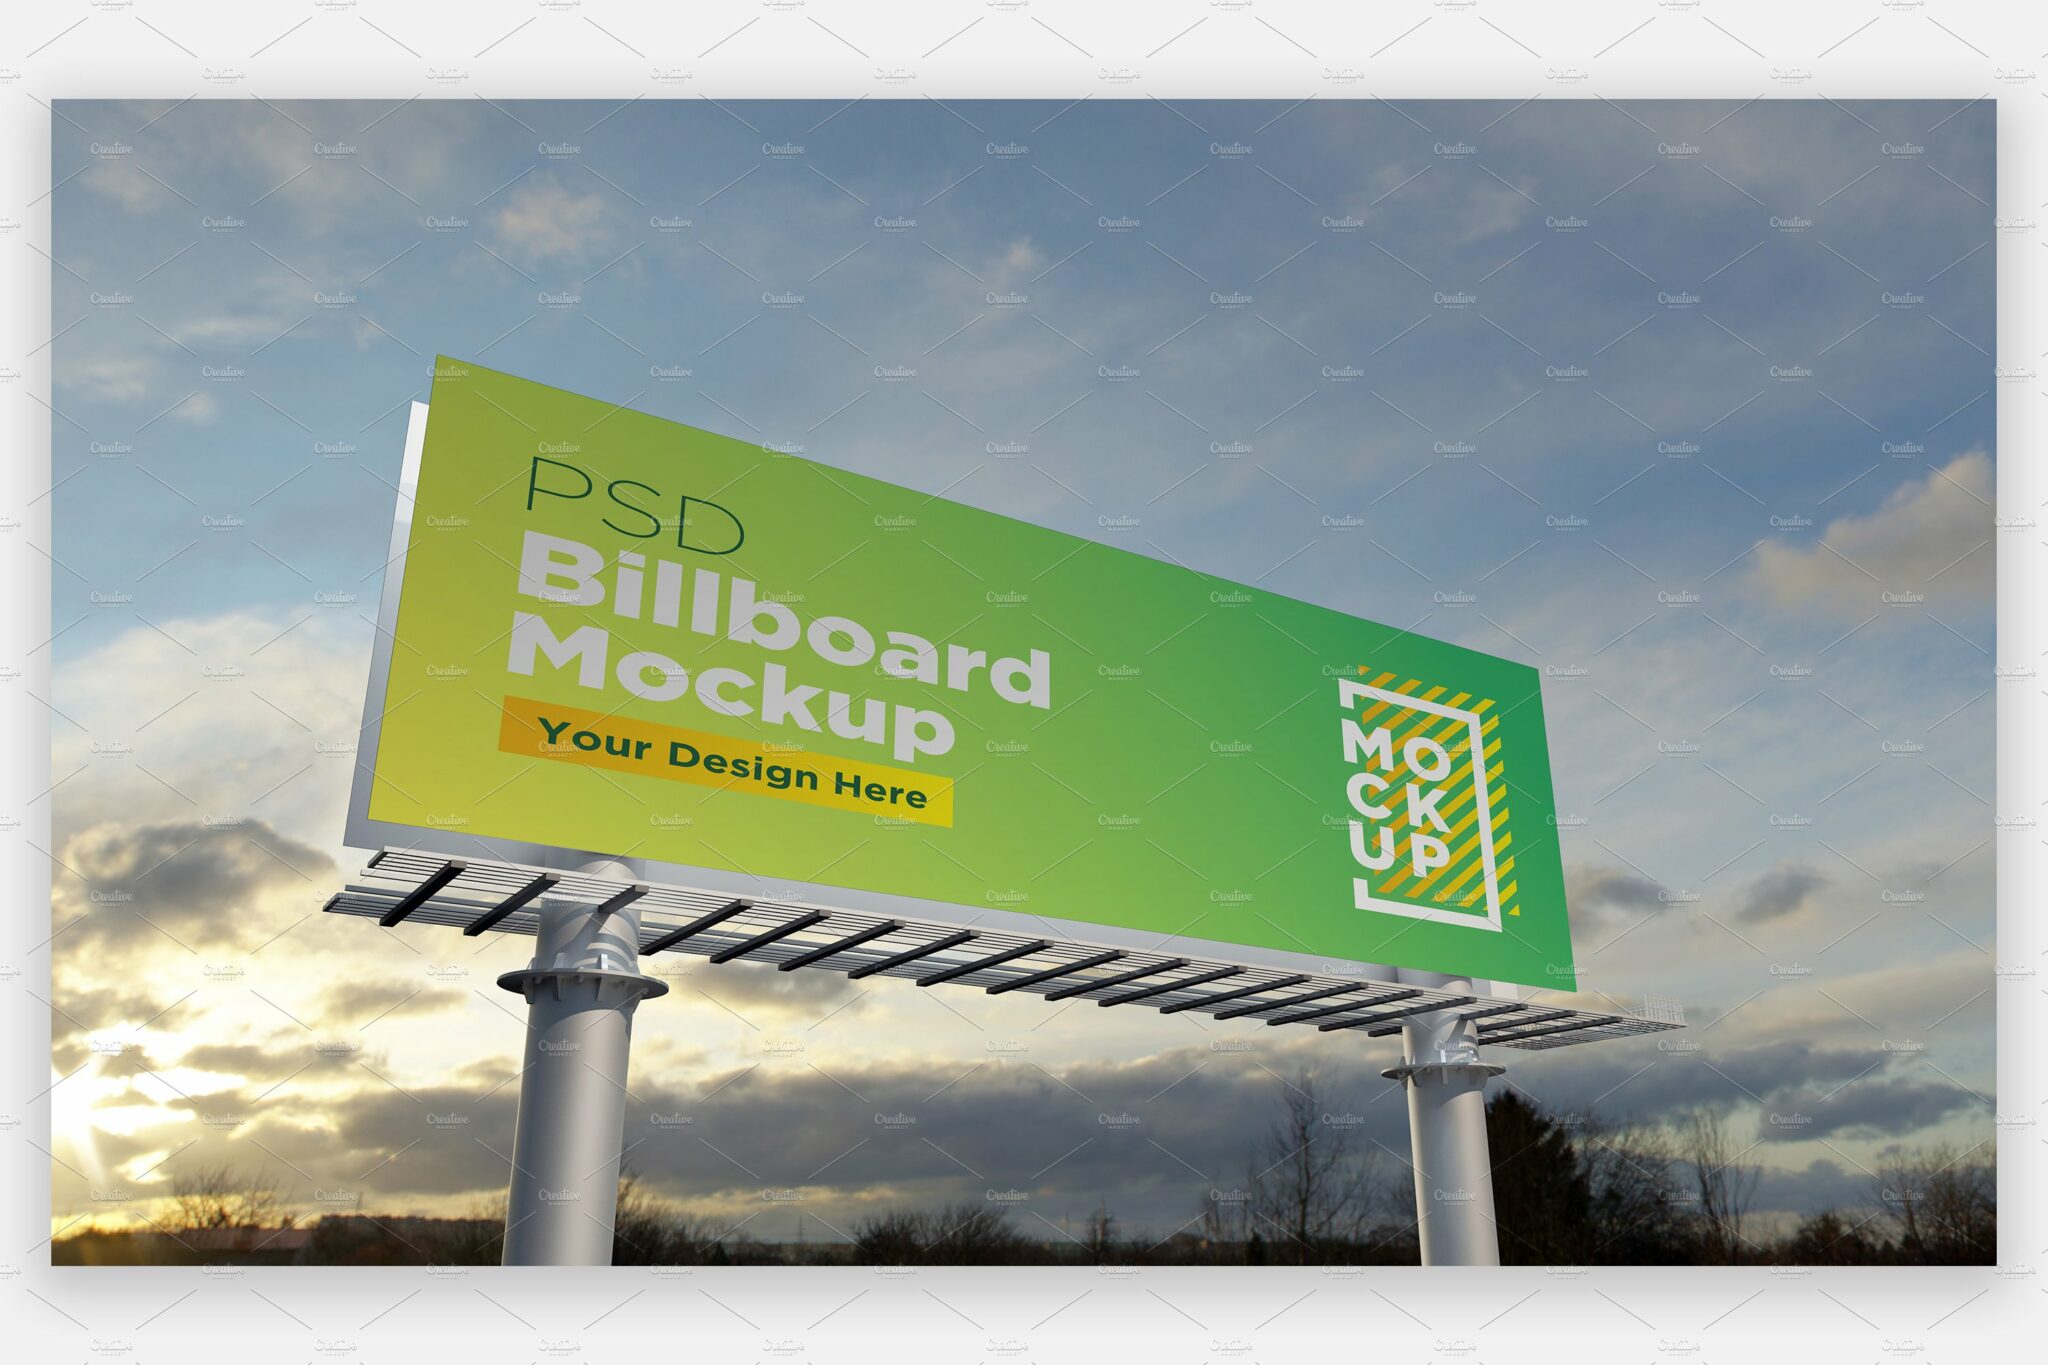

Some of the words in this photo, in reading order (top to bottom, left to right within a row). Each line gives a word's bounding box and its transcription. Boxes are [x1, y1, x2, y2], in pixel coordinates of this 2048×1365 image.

[527, 456, 745, 555] PSD
[517, 529, 1051, 710] Billboard
[507, 610, 956, 763] Mockup
[537, 716, 652, 761] Your
[669, 741, 818, 791] Design
[835, 771, 928, 809] Here
